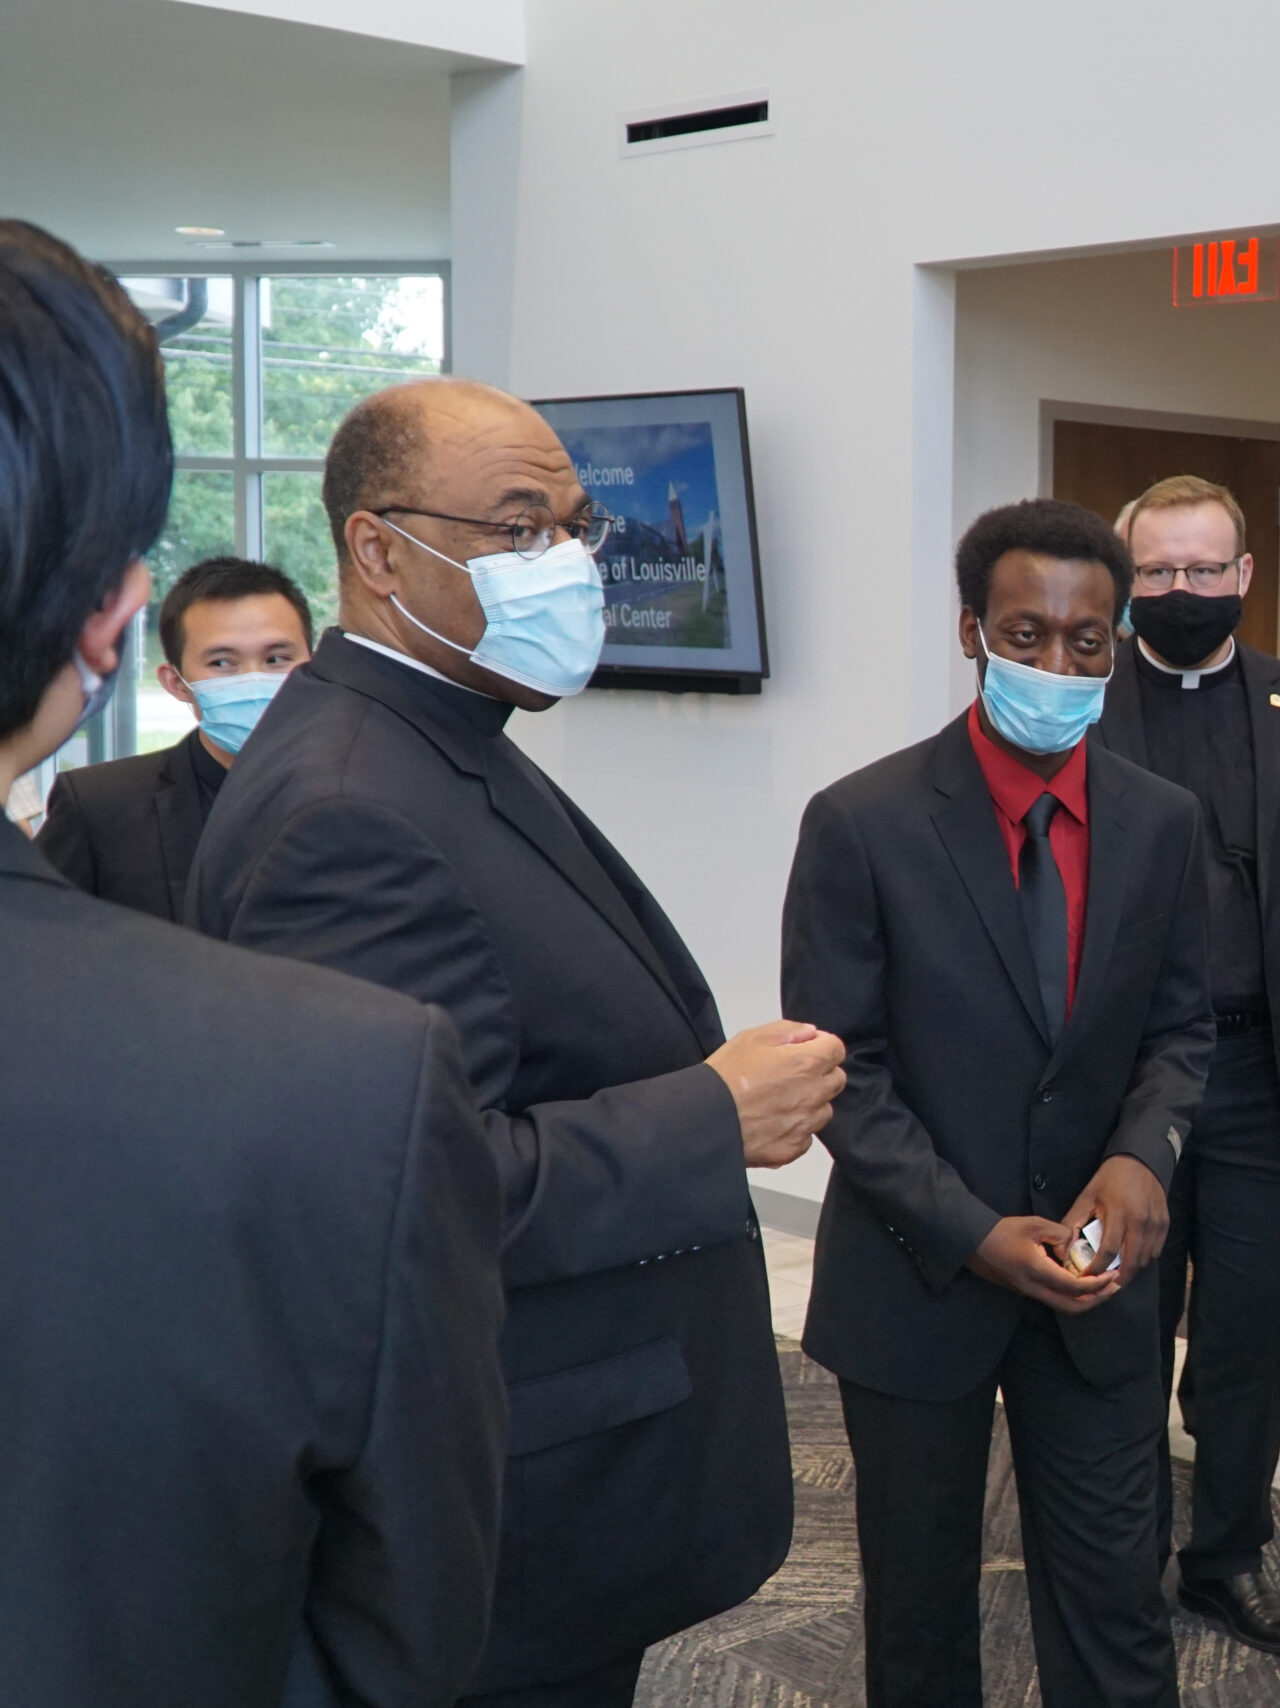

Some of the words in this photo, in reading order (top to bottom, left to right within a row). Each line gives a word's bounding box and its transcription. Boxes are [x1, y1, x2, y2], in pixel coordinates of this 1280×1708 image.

[575, 462, 634, 486] elcome
[611, 556, 627, 580] of
[630, 556, 706, 582] Louisville
[620, 603, 672, 628] Center
